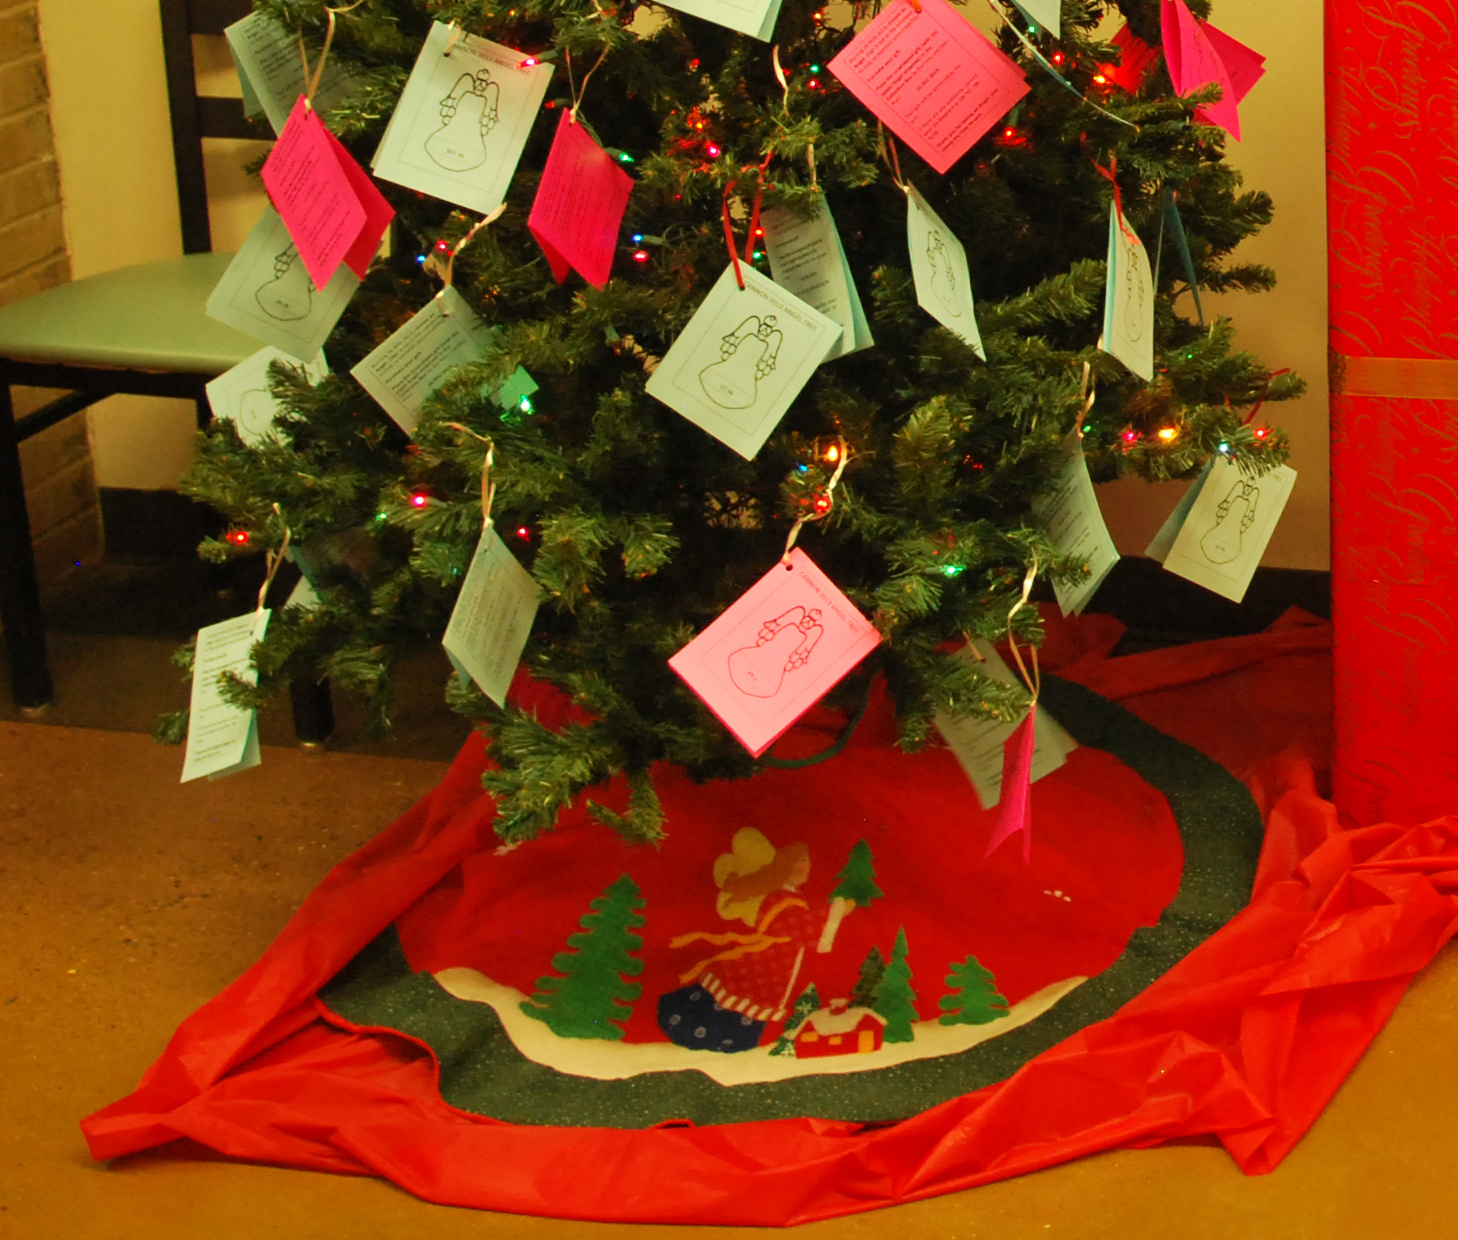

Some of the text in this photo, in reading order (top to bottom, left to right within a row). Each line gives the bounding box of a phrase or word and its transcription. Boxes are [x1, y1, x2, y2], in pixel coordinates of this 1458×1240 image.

[742, 279, 817, 331] CANNON 2013 ANGEL TREE
[798, 570, 858, 633] CANNON 2013 ANGEL TREE
